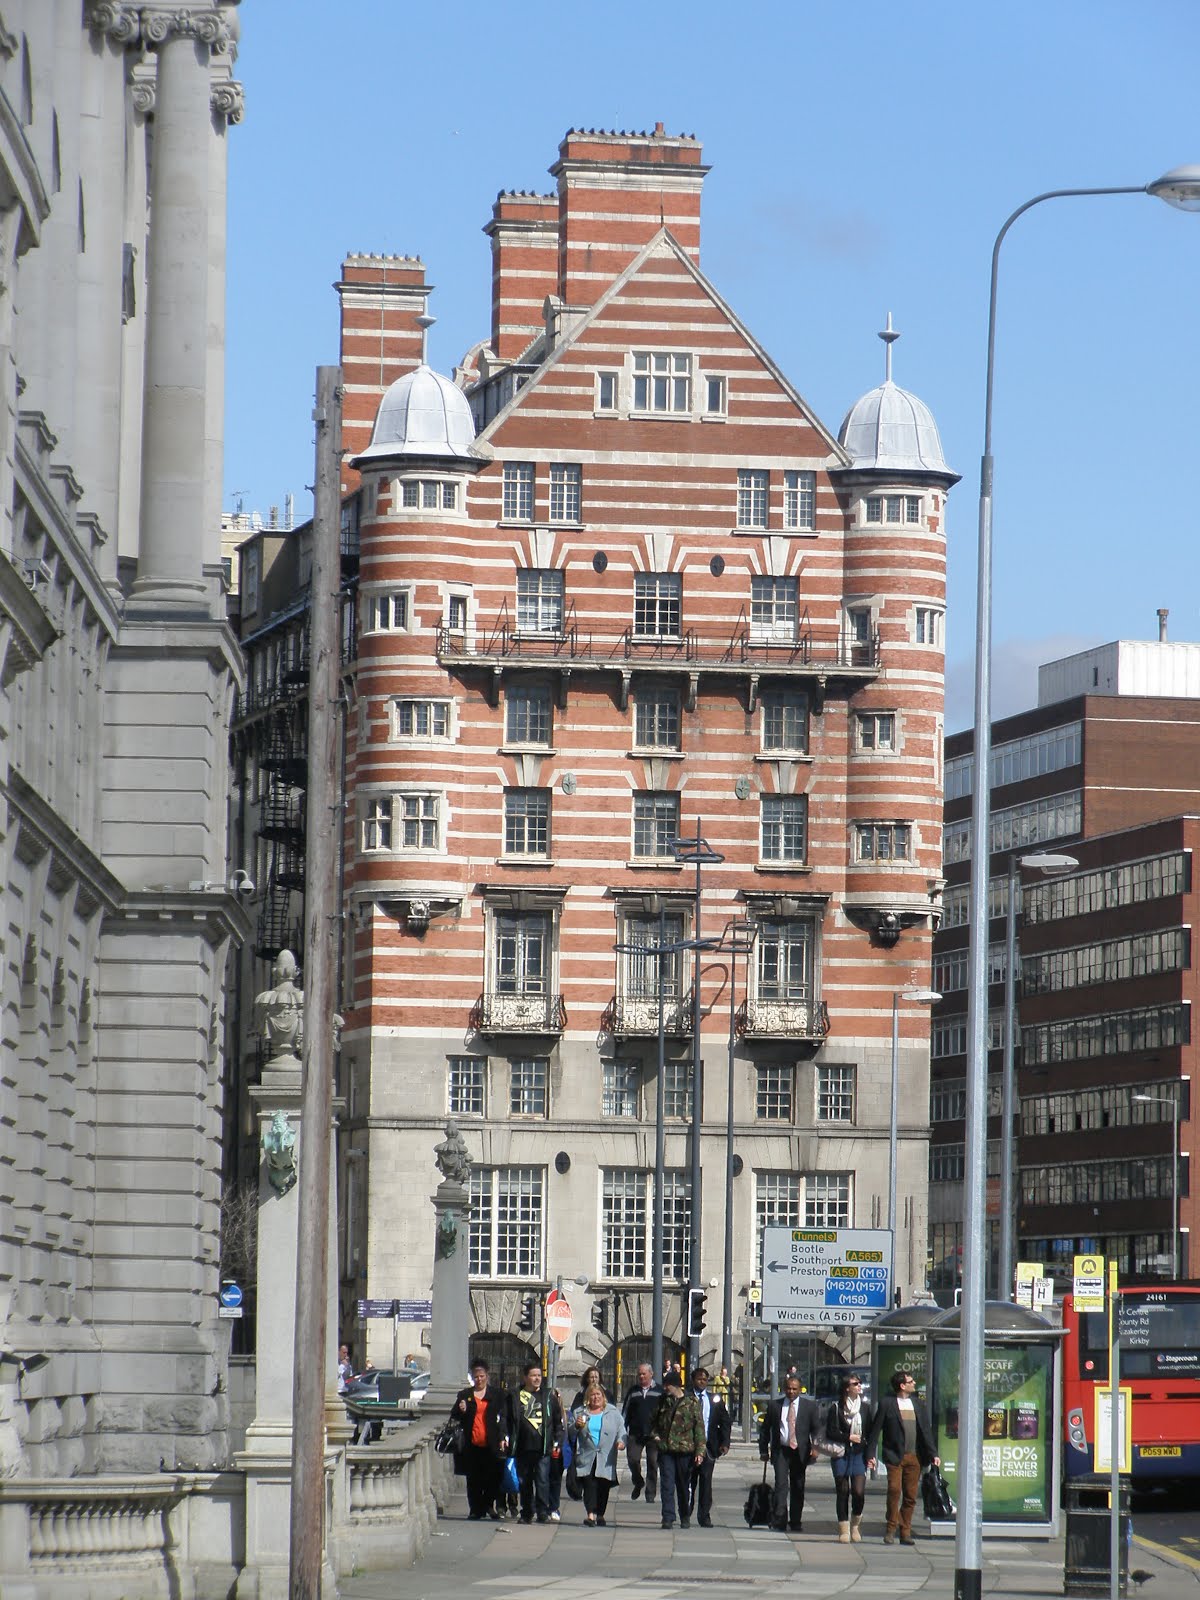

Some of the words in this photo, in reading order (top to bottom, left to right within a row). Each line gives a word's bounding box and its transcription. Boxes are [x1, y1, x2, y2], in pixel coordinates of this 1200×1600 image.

[792, 1231, 836, 1242] (Tunnels)
[791, 1244, 825, 1254] Bootle
[791, 1255, 842, 1266] Southport
[846, 1250, 882, 1262] (A565)
[790, 1266, 828, 1276] Preston
[826, 1280, 855, 1292] (M62)
[856, 1281, 885, 1293] (M57)
[1037, 1288, 1046, 1299] H
[839, 1293, 868, 1305] (M58)
[777, 1310, 815, 1321] Widnes
[1126, 1308, 1149, 1316] Centre
[1119, 1319, 1138, 1327] ounty
[1129, 1337, 1150, 1346] Kirkby
[1165, 1355, 1198, 1363] Stagecoach
[1002, 1447, 1038, 1461] 50%
[1001, 1461, 1038, 1470] FEWER
[1001, 1470, 1038, 1478] LORRIES
